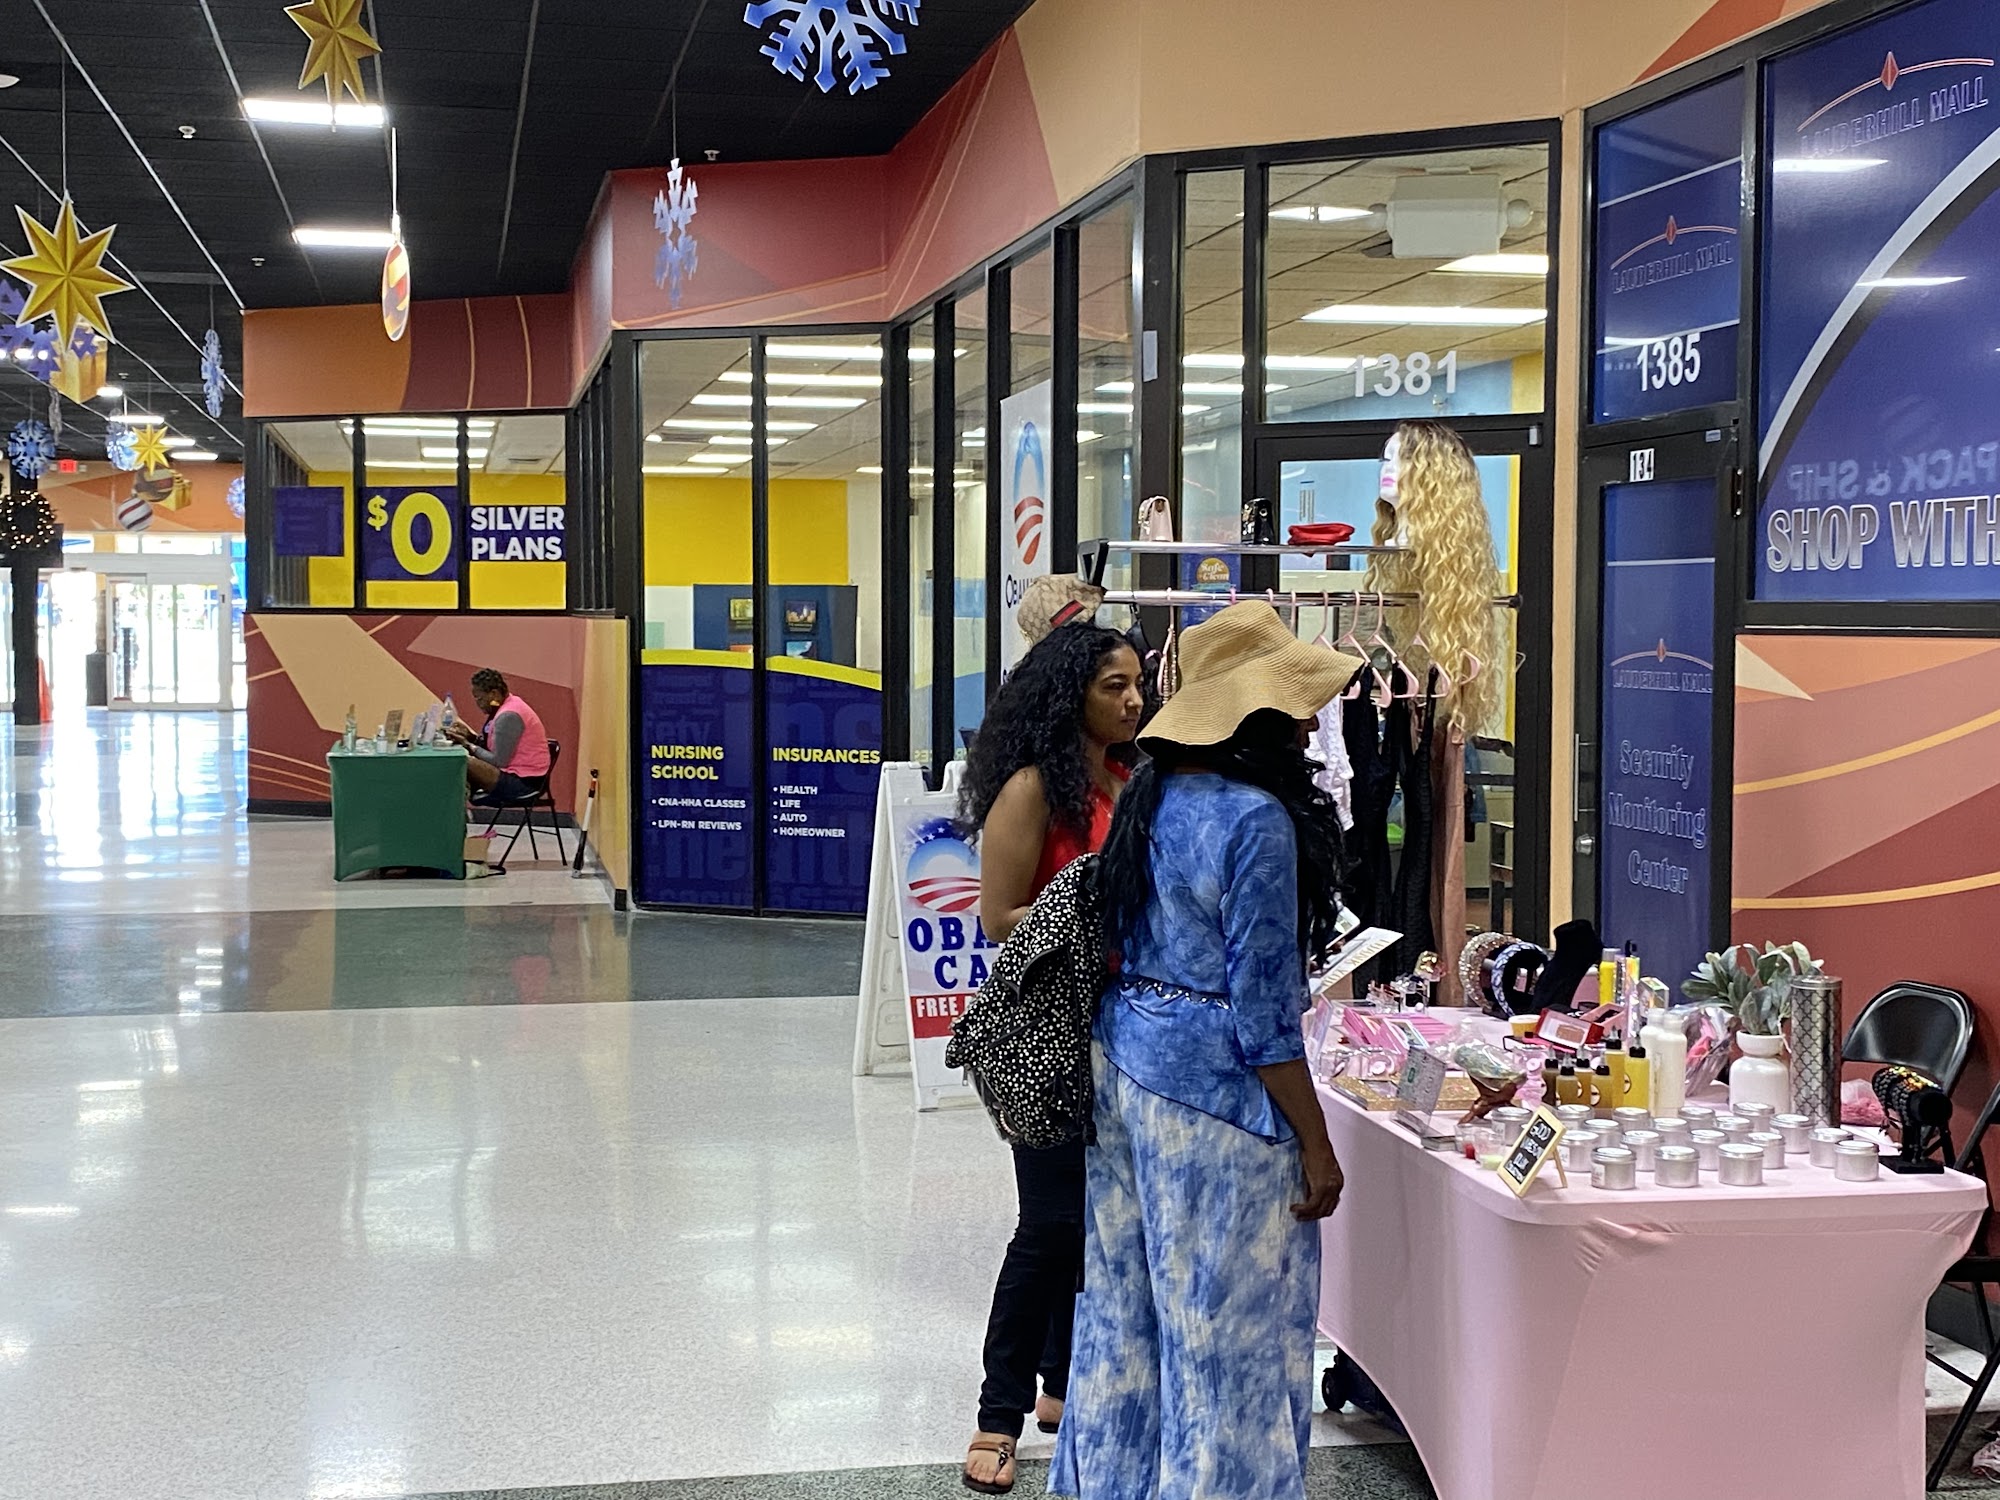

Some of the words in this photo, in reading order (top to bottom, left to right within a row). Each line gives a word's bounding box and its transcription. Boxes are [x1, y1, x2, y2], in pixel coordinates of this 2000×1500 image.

[1929, 76, 1989, 122] MALL
[1695, 240, 1735, 272] MALL
[1345, 350, 1457, 398] 1381
[1636, 332, 1701, 392] 1385
[1632, 450, 1652, 481] 134
[470, 506, 565, 531] SILVER
[1766, 504, 1880, 573] SHOP
[1889, 494, 2000, 569] WITH
[471, 536, 562, 561] PLANS
[651, 745, 724, 760] NURSING
[772, 747, 881, 764] INSURANCES
[1619, 739, 1695, 790] Security
[651, 765, 719, 781] SCHOOL
[657, 797, 702, 808] CNA-HHA
[703, 798, 746, 809] CLASSES
[779, 785, 818, 796] HEALTH
[779, 799, 801, 809] LIFE
[657, 819, 696, 830] LPN-RN
[697, 820, 742, 831] REVIEWS
[779, 813, 808, 823] AUTO
[1608, 791, 1707, 849] Monitoring
[779, 826, 846, 838] HOMEOWNER
[1627, 849, 1690, 894] Center
[915, 996, 959, 1018] FREE
